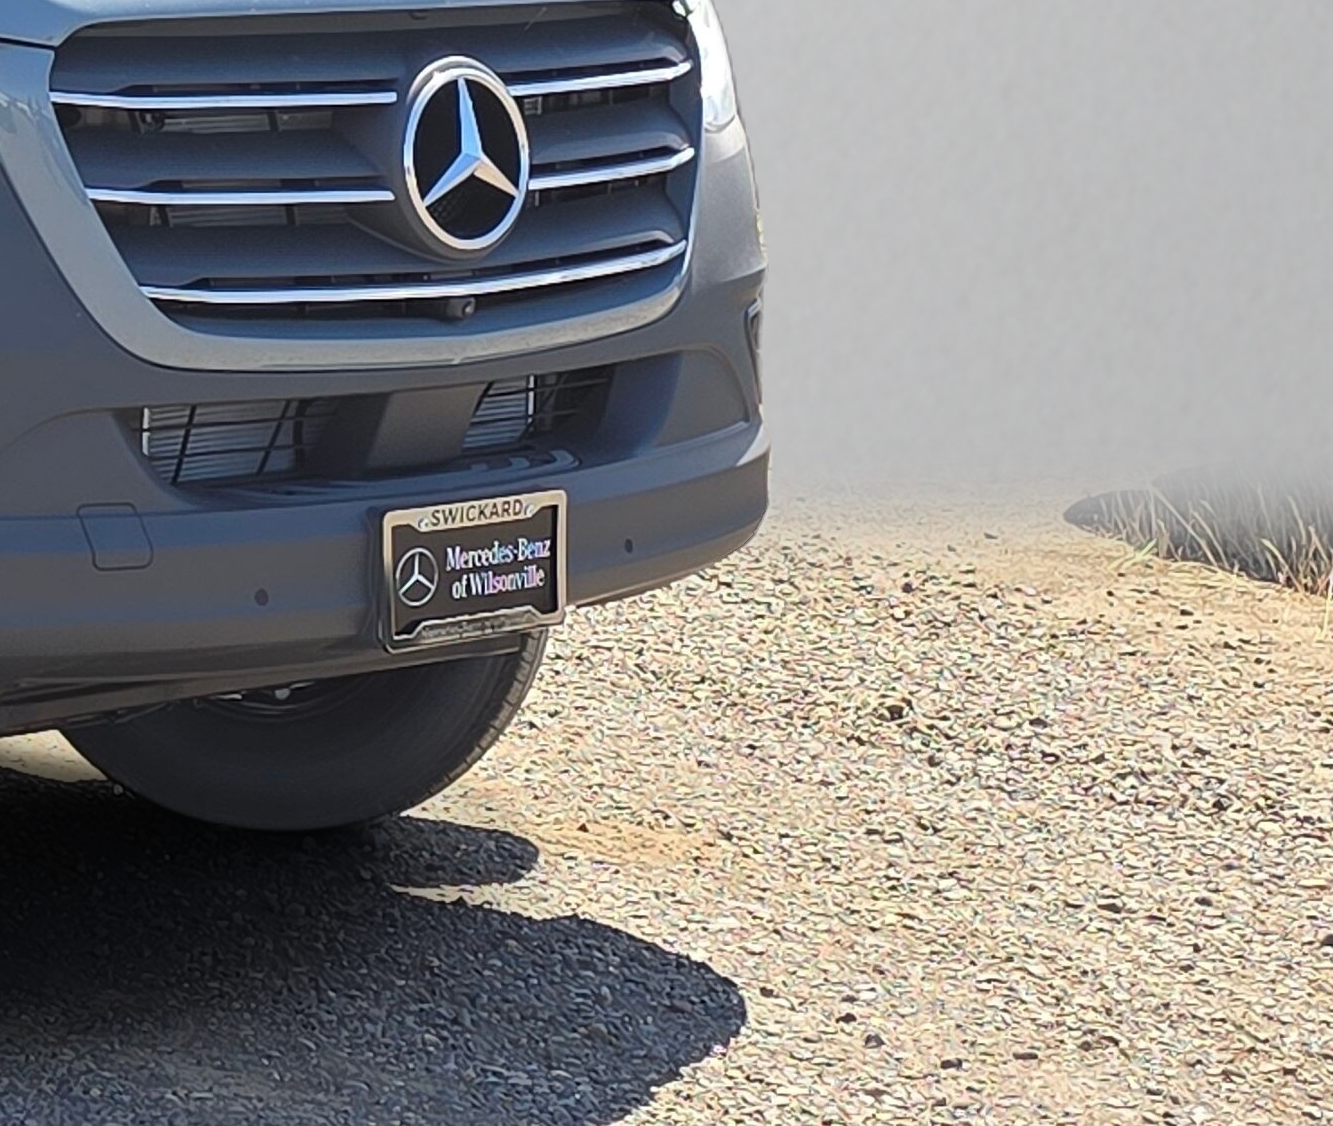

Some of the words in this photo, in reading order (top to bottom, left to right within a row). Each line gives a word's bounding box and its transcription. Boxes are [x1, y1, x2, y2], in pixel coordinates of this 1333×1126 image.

[431, 499, 524, 525] SWICKARD
[446, 538, 551, 572] Mercedes-Benz
[451, 573, 468, 599] of
[469, 565, 545, 595] Wilsonville
